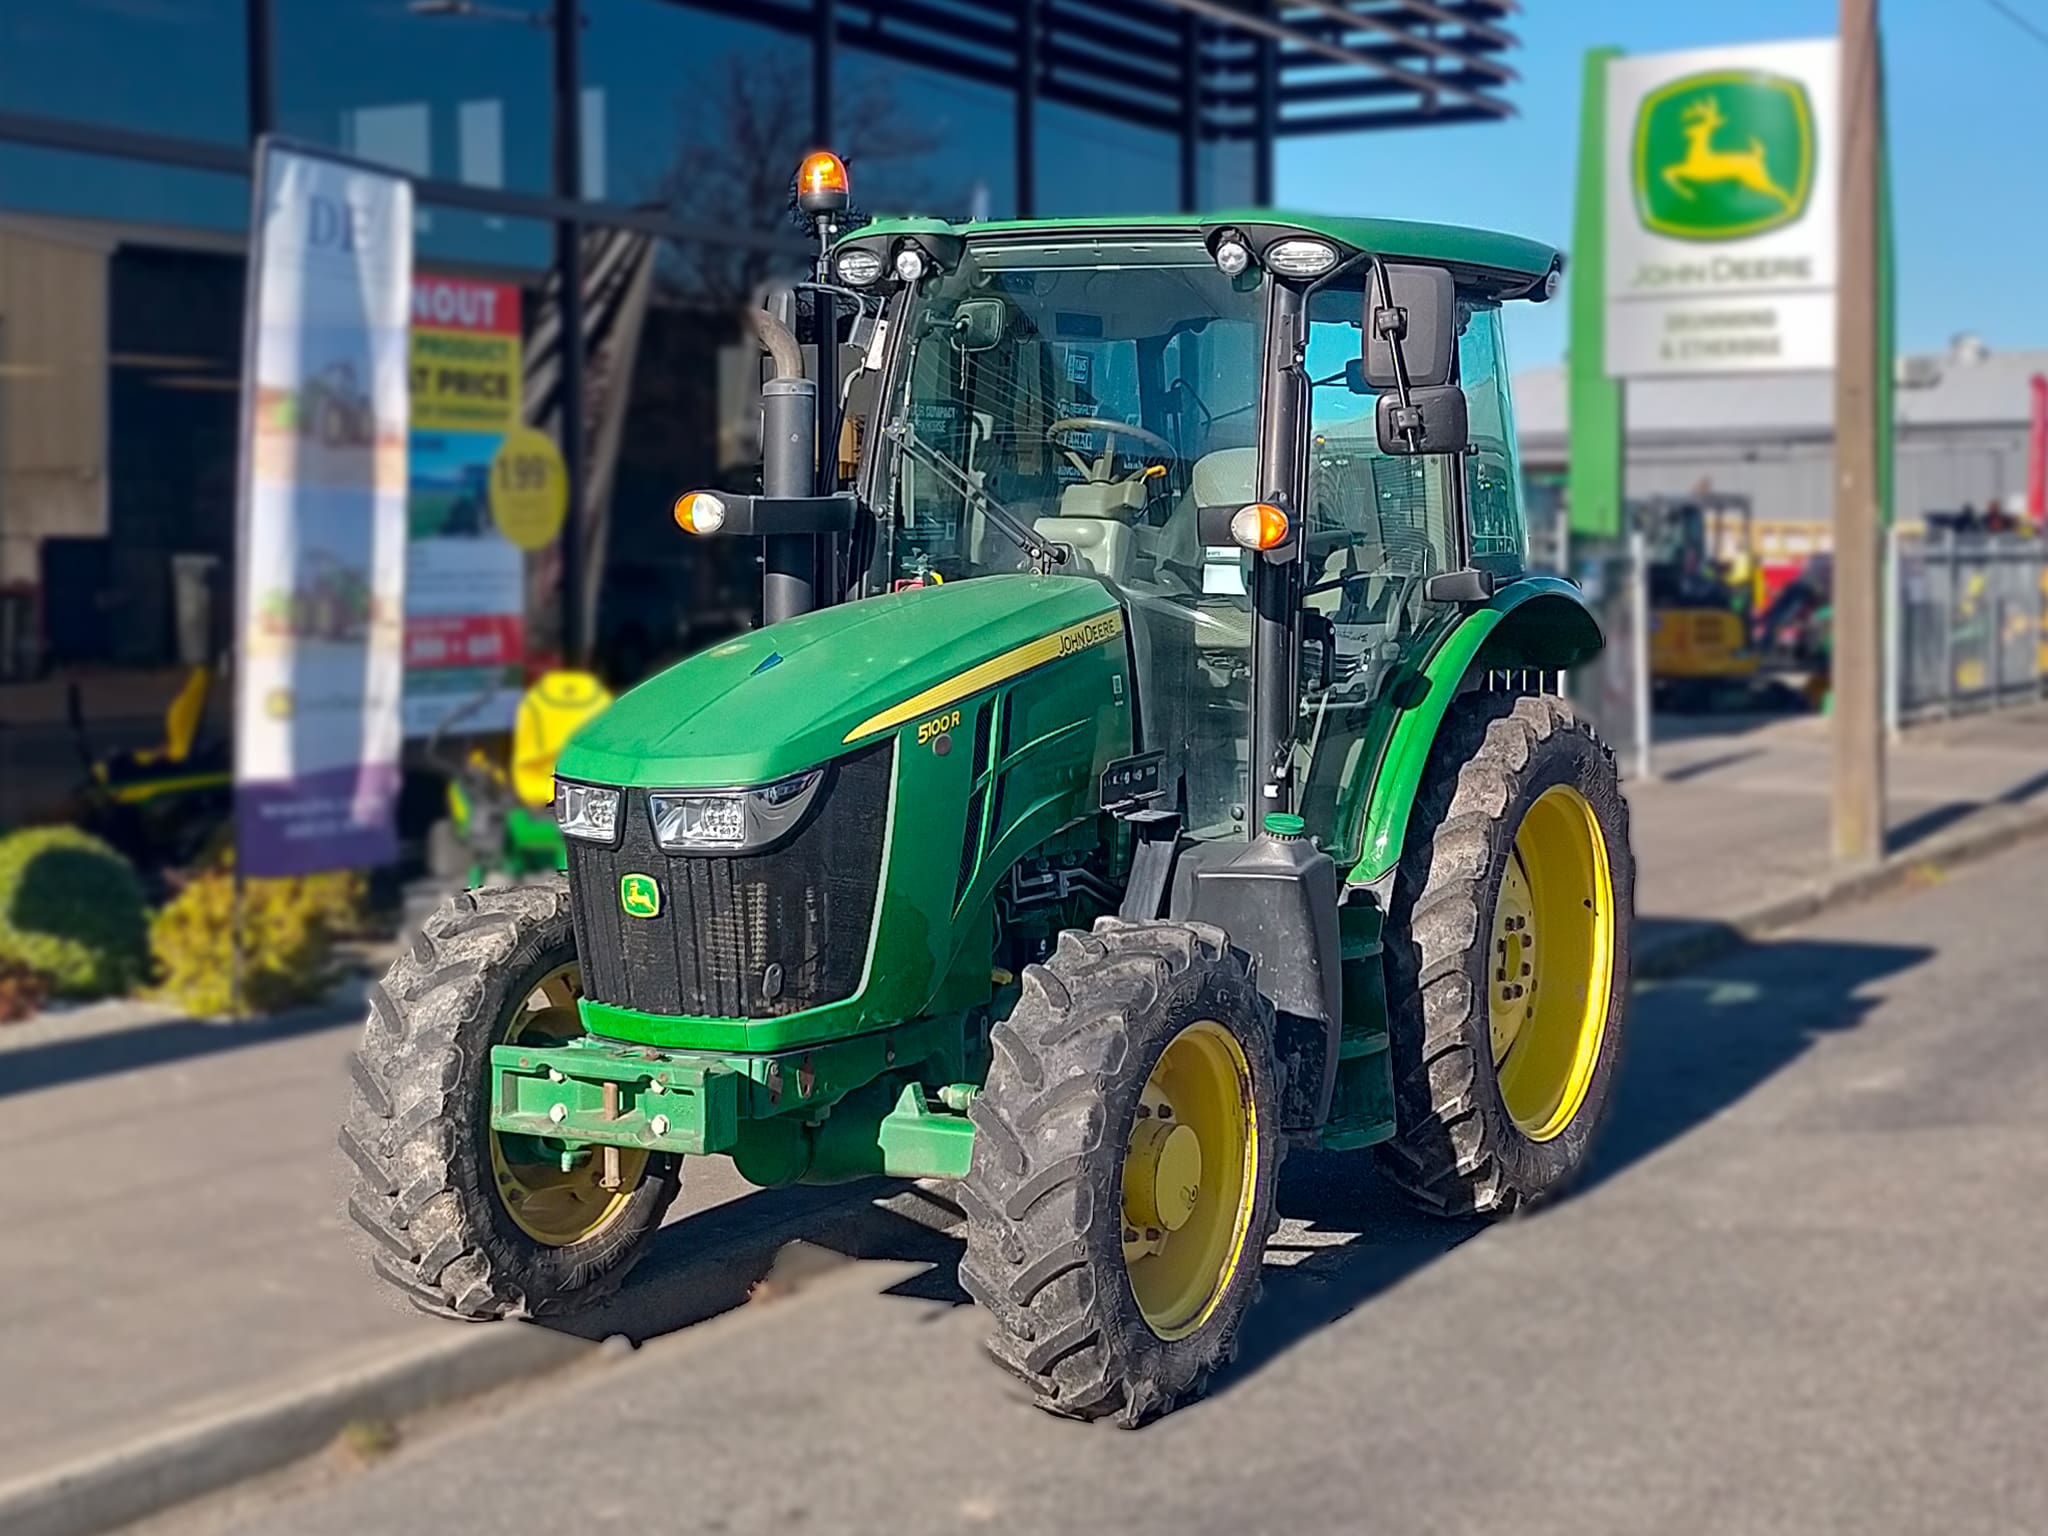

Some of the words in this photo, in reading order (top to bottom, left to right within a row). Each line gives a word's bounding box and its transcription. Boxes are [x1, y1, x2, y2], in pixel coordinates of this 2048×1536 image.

[1711, 256, 1812, 282] DEERE
[437, 368, 510, 400] PRICE
[1059, 631, 1086, 655] JOHN
[1084, 618, 1115, 644] DEERE
